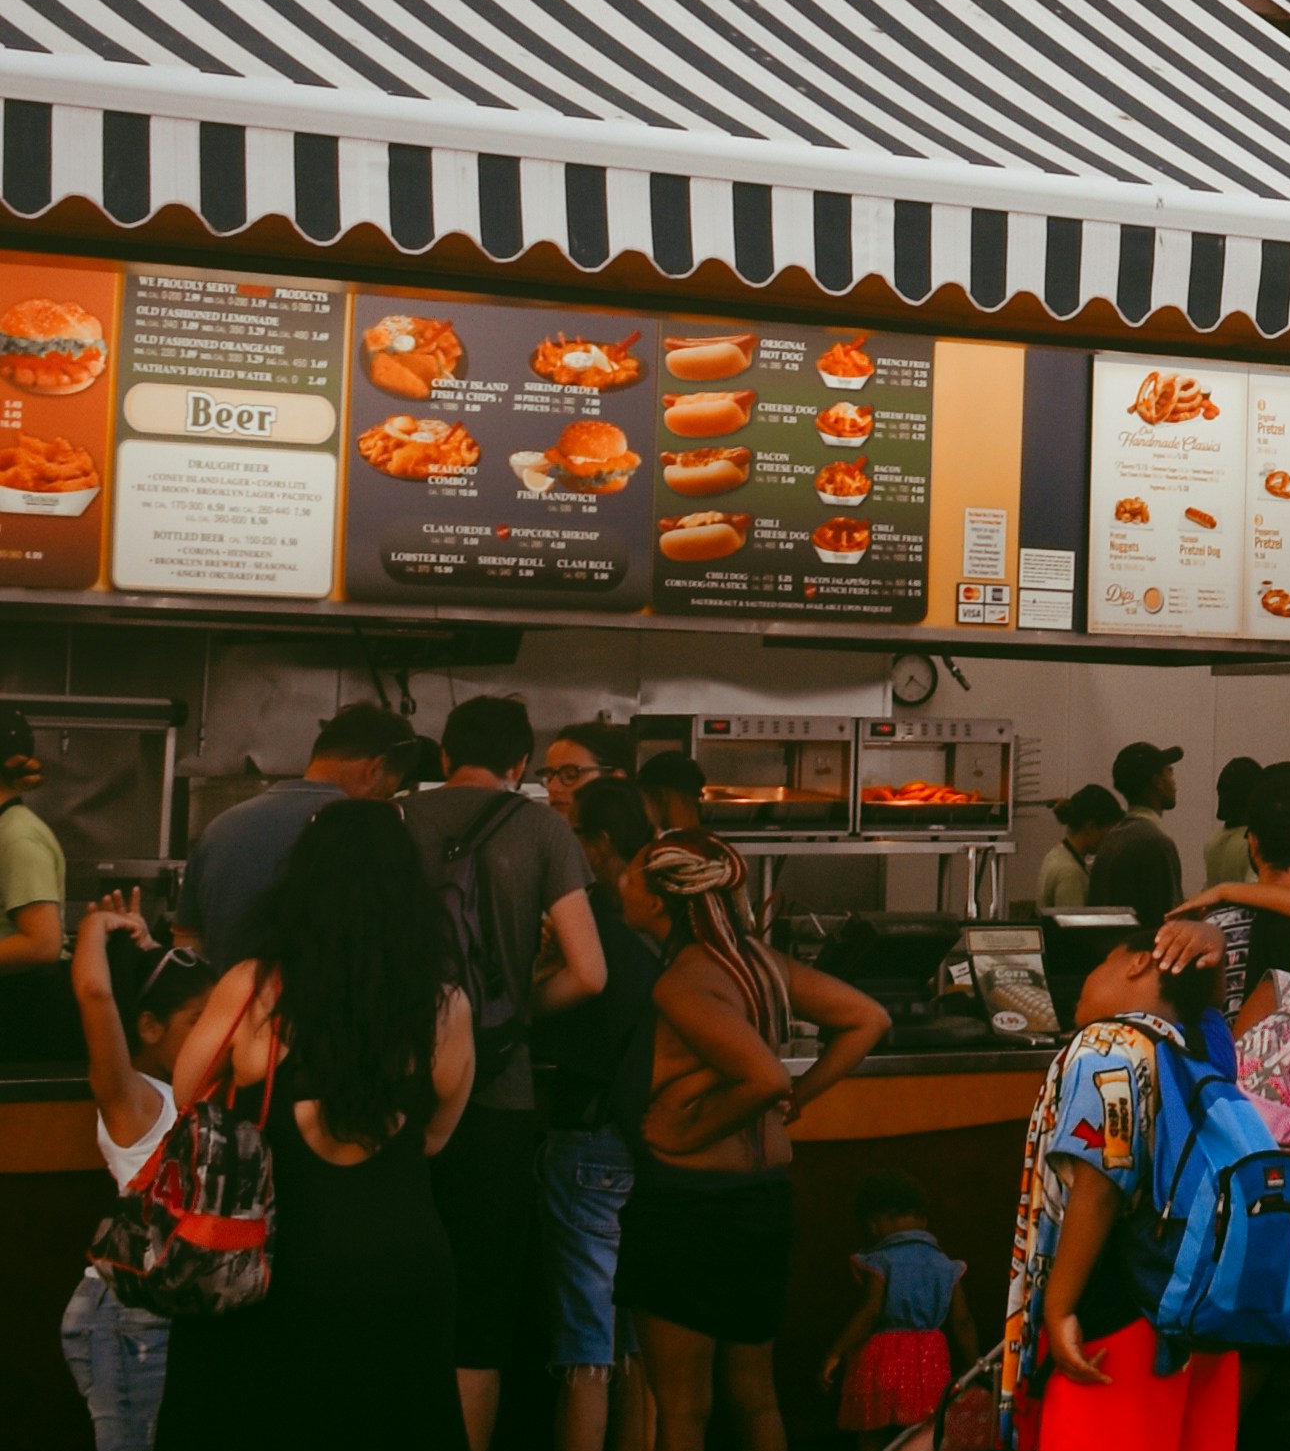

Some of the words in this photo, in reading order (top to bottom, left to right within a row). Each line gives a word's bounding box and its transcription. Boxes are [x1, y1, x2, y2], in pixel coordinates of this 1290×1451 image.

[157, 278, 204, 290] PROUDLY
[206, 282, 237, 294] SERVE
[275, 288, 328, 302] PRODUCTS
[136, 306, 158, 316] OLD
[161, 308, 220, 321] FASHIONED
[222, 313, 280, 326] LEMONADE
[134, 334, 157, 345] OLD
[159, 336, 219, 349] FASHIONED
[220, 341, 285, 355] ORANGEADE
[760, 339, 807, 351] ORIGINAL
[759, 350, 781, 361] HOT
[782, 352, 804, 362] DOG
[133, 362, 186, 376] NATHAN'S
[187, 367, 235, 379] BOTTLED
[237, 370, 272, 383] WATER
[470, 380, 509, 392] ISLAND
[189, 394, 276, 434] Beer
[795, 405, 817, 415] DOG
[1257, 422, 1286, 436] Pretzel
[1118, 431, 1180, 450] Handmade
[1182, 436, 1221, 452] Classics
[756, 452, 790, 462] BACON
[188, 459, 240, 472] DRAUGHT
[243, 462, 269, 473] BEER
[756, 463, 792, 473] CHEESE
[793, 465, 815, 475] DOG
[185, 474, 219, 484] ISLAND
[154, 530, 199, 542] BOTTLED
[201, 532, 224, 543] BEER
[422, 523, 454, 534] CLAM
[455, 525, 492, 536] ORDER
[511, 528, 559, 539] POPCORN
[790, 531, 810, 541] DOG
[1110, 542, 1139, 553] Nuggets
[1179, 544, 1205, 556] Pretzel
[1208, 546, 1221, 558] Dog
[1254, 536, 1283, 550] Pretzel
[391, 552, 438, 563] LOBSTER
[439, 553, 467, 564] ROLL
[519, 557, 546, 567] ROLL
[557, 558, 587, 569] CLAM
[588, 560, 615, 570] ROLL
[1105, 584, 1135, 604] Dips
[994, 968, 1030, 979] Corn
